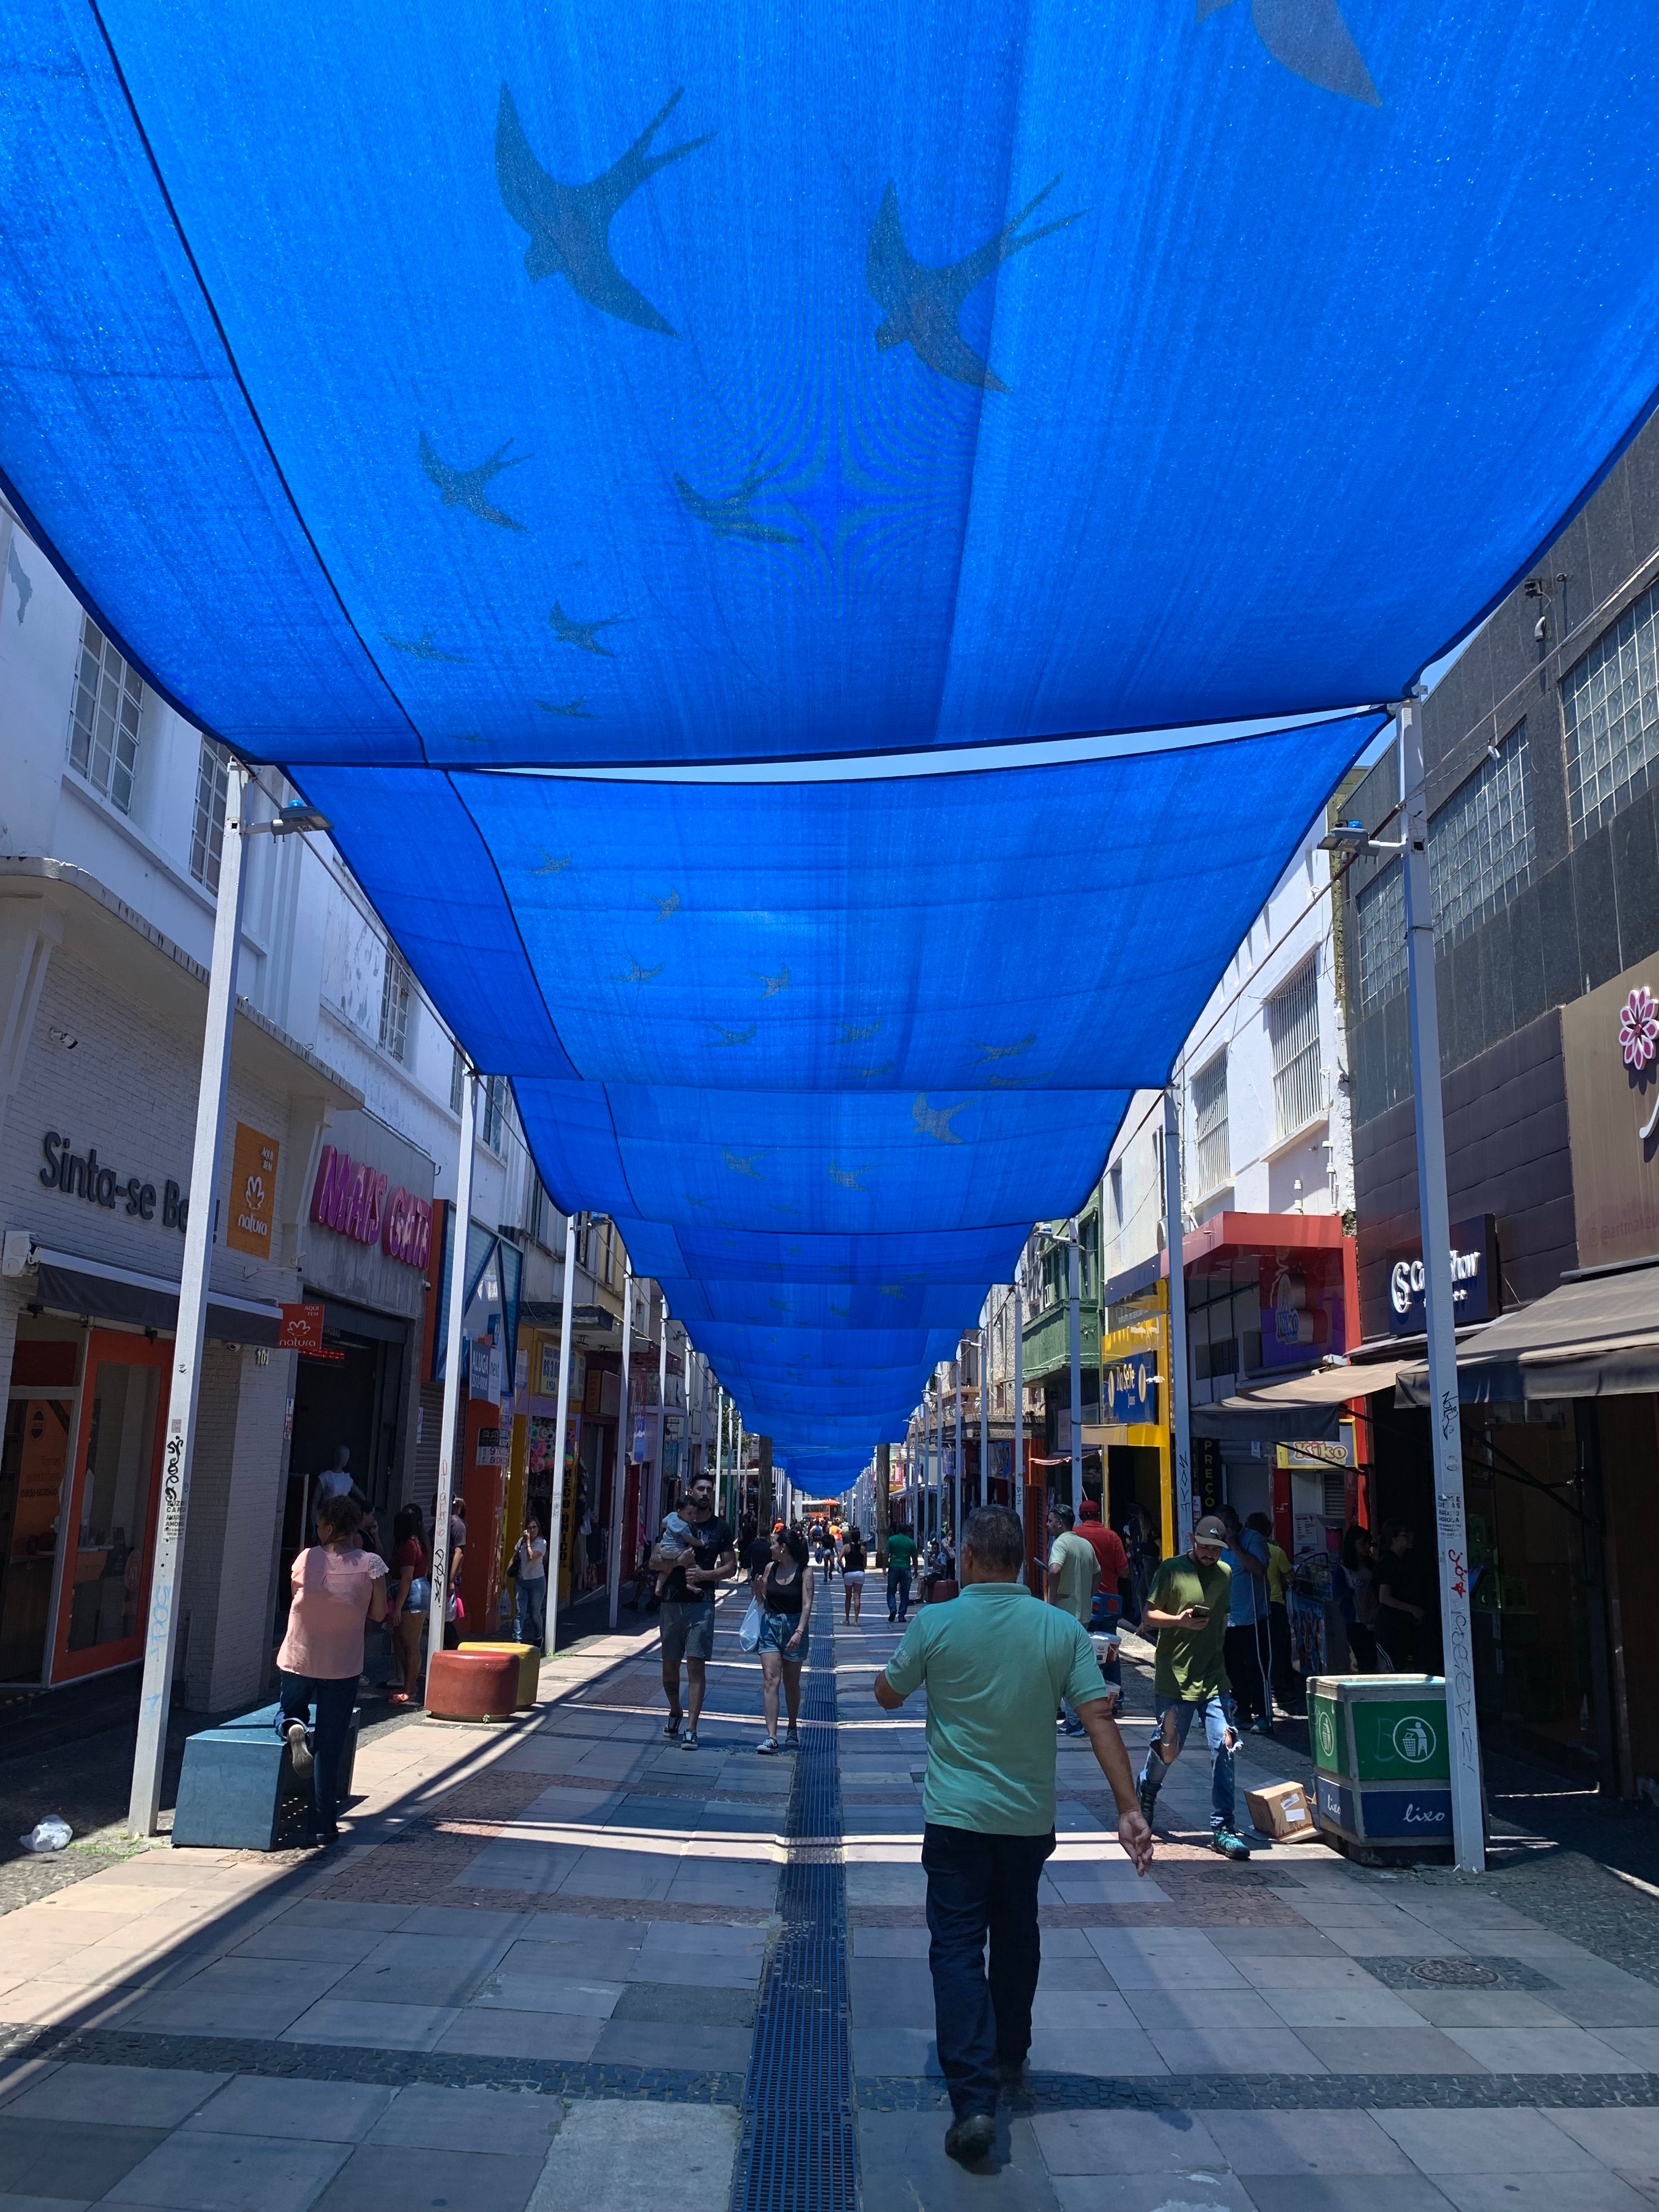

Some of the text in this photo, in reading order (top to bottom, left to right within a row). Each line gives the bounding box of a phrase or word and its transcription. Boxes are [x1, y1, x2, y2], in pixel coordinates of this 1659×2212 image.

[261, 1147, 274, 1161] AQUI
[263, 1159, 273, 1172] TEM
[40, 1132, 156, 1220] Sinta-se
[239, 1213, 268, 1235] natura
[279, 1338, 315, 1347] natura
[257, 1348, 269, 1365] 101
[472, 1350, 488, 1375] ALUGA
[1295, 1442, 1346, 1459] Kiko
[1204, 1440, 1215, 1507] PREÇO
[1327, 1793, 1341, 1815] lixo
[1403, 1804, 1446, 1822] lixo
